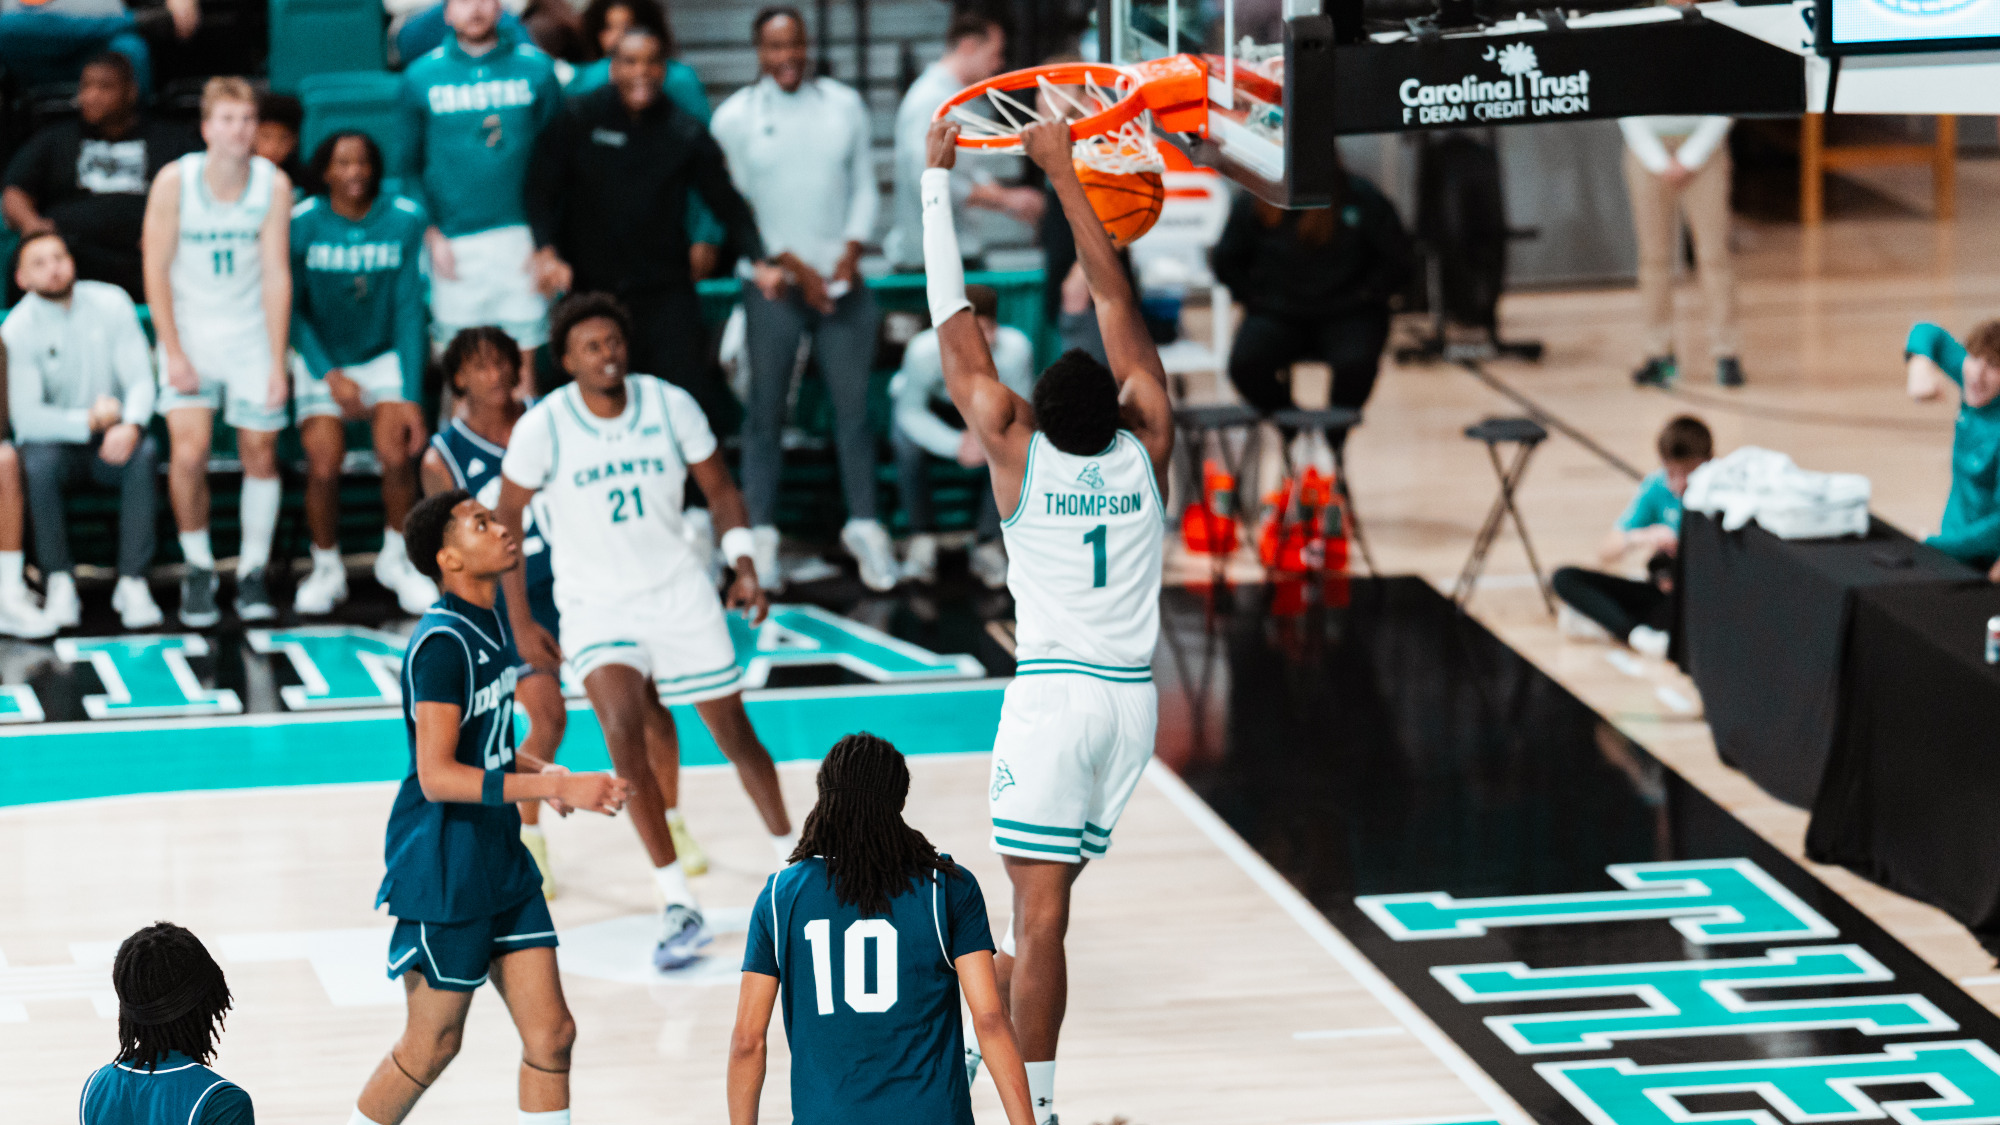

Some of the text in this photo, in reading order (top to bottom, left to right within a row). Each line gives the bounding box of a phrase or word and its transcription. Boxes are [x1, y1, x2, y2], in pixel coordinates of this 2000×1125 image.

[1399, 69, 1591, 107] Carolina Trust
[1532, 95, 1590, 116] UNION
[213, 248, 235, 276] 11
[573, 457, 664, 487] CHANTS
[608, 484, 644, 523] 21
[1043, 491, 1141, 516] THOMPSON
[1083, 524, 1107, 588] 1
[484, 698, 513, 770] 22
[803, 918, 898, 1016] 10
